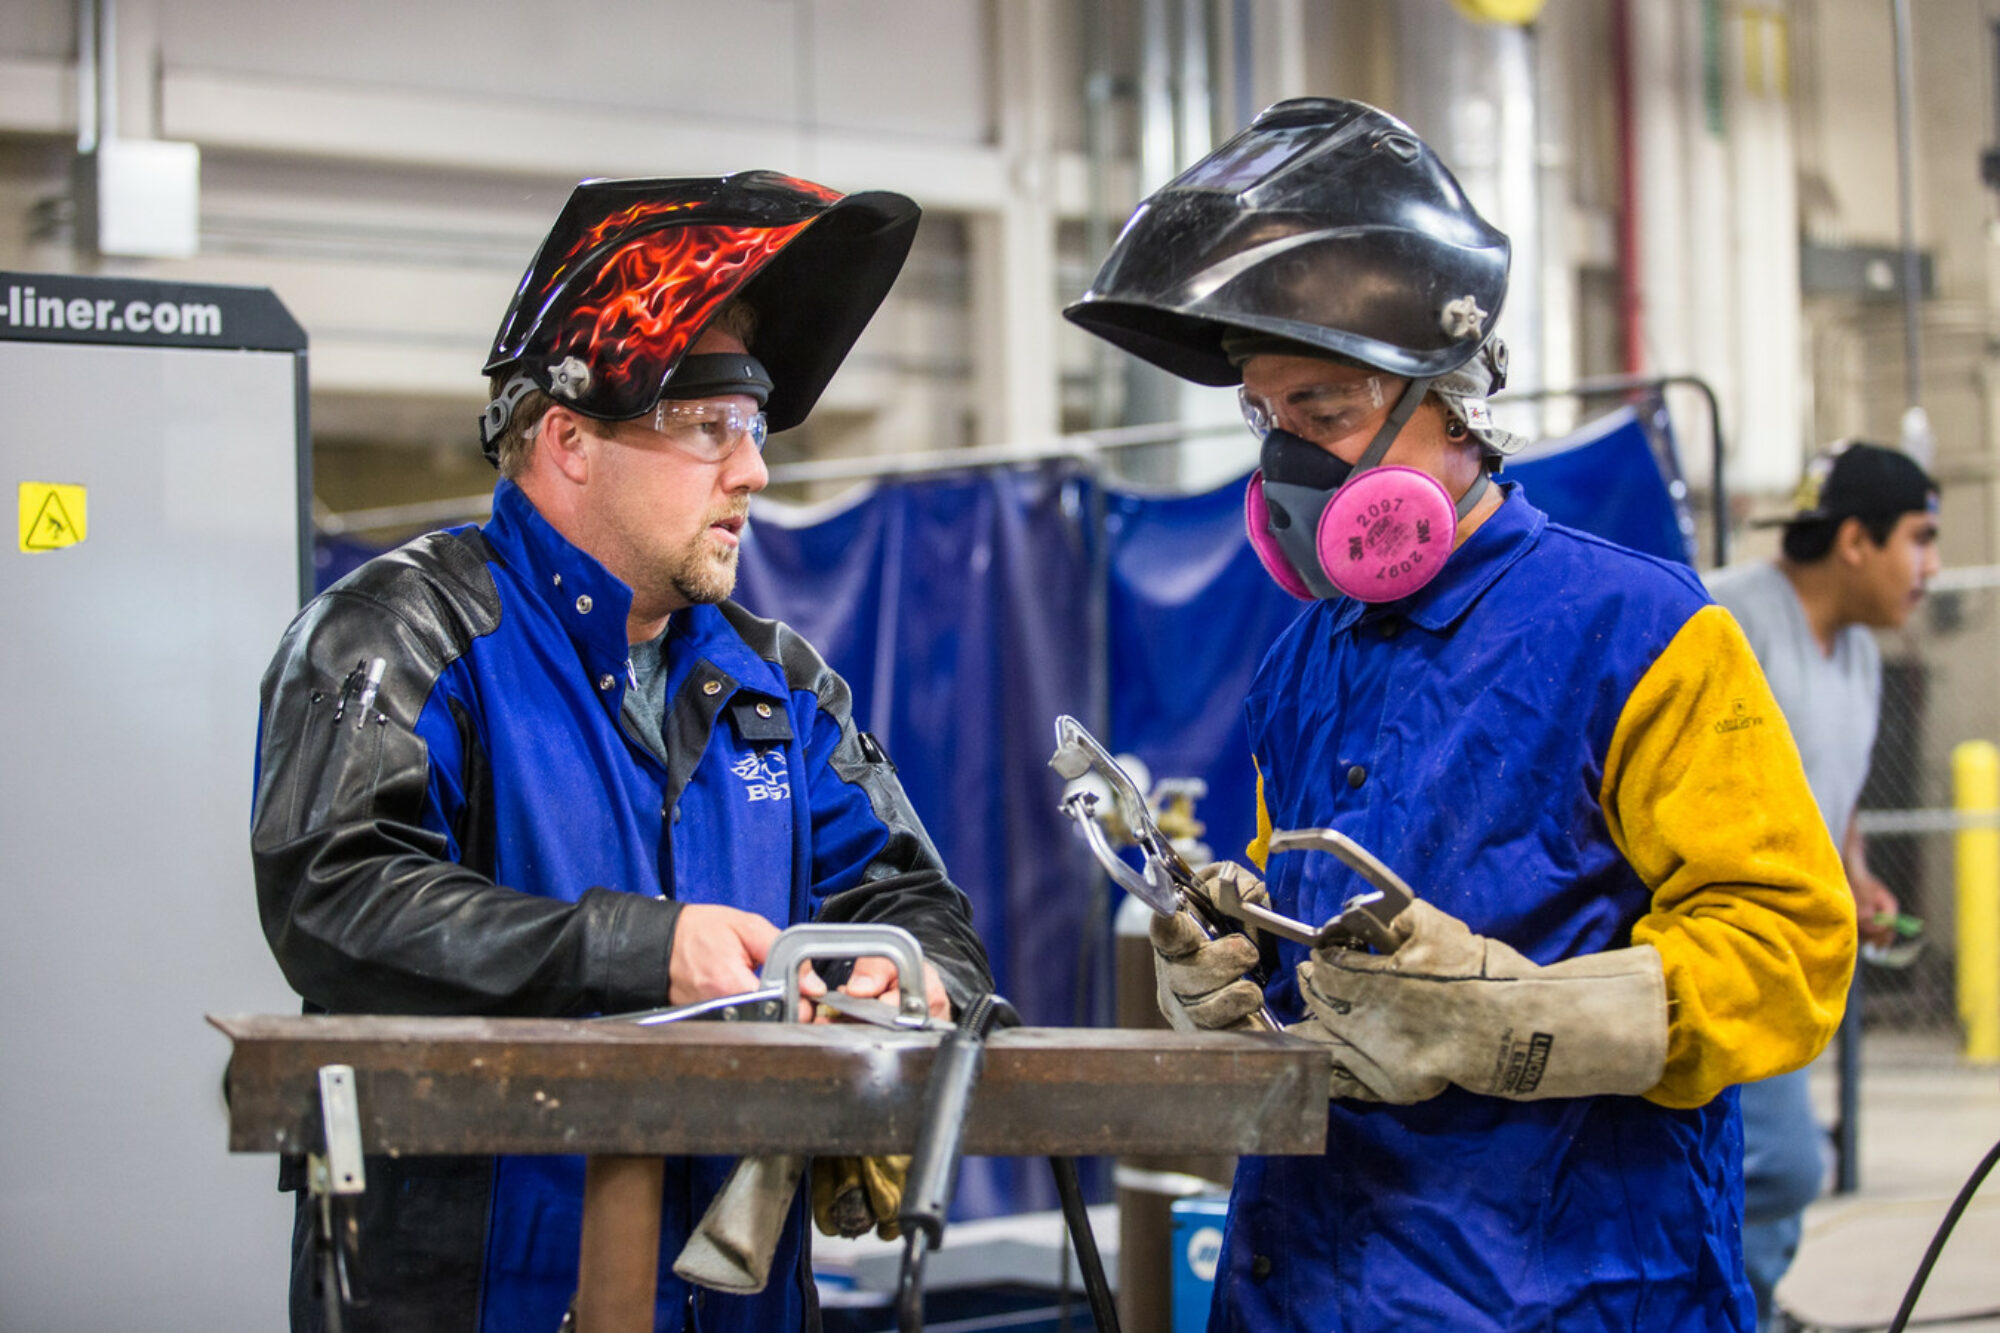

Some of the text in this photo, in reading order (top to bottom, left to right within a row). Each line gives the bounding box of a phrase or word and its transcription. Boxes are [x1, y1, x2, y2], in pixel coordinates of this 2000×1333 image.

[0, 286, 222, 335] -liner.com
[1356, 498, 1404, 528] 2097
[1416, 518, 1431, 544] 3M
[1348, 536, 1364, 561] 3M
[1376, 551, 1423, 580] 2097
